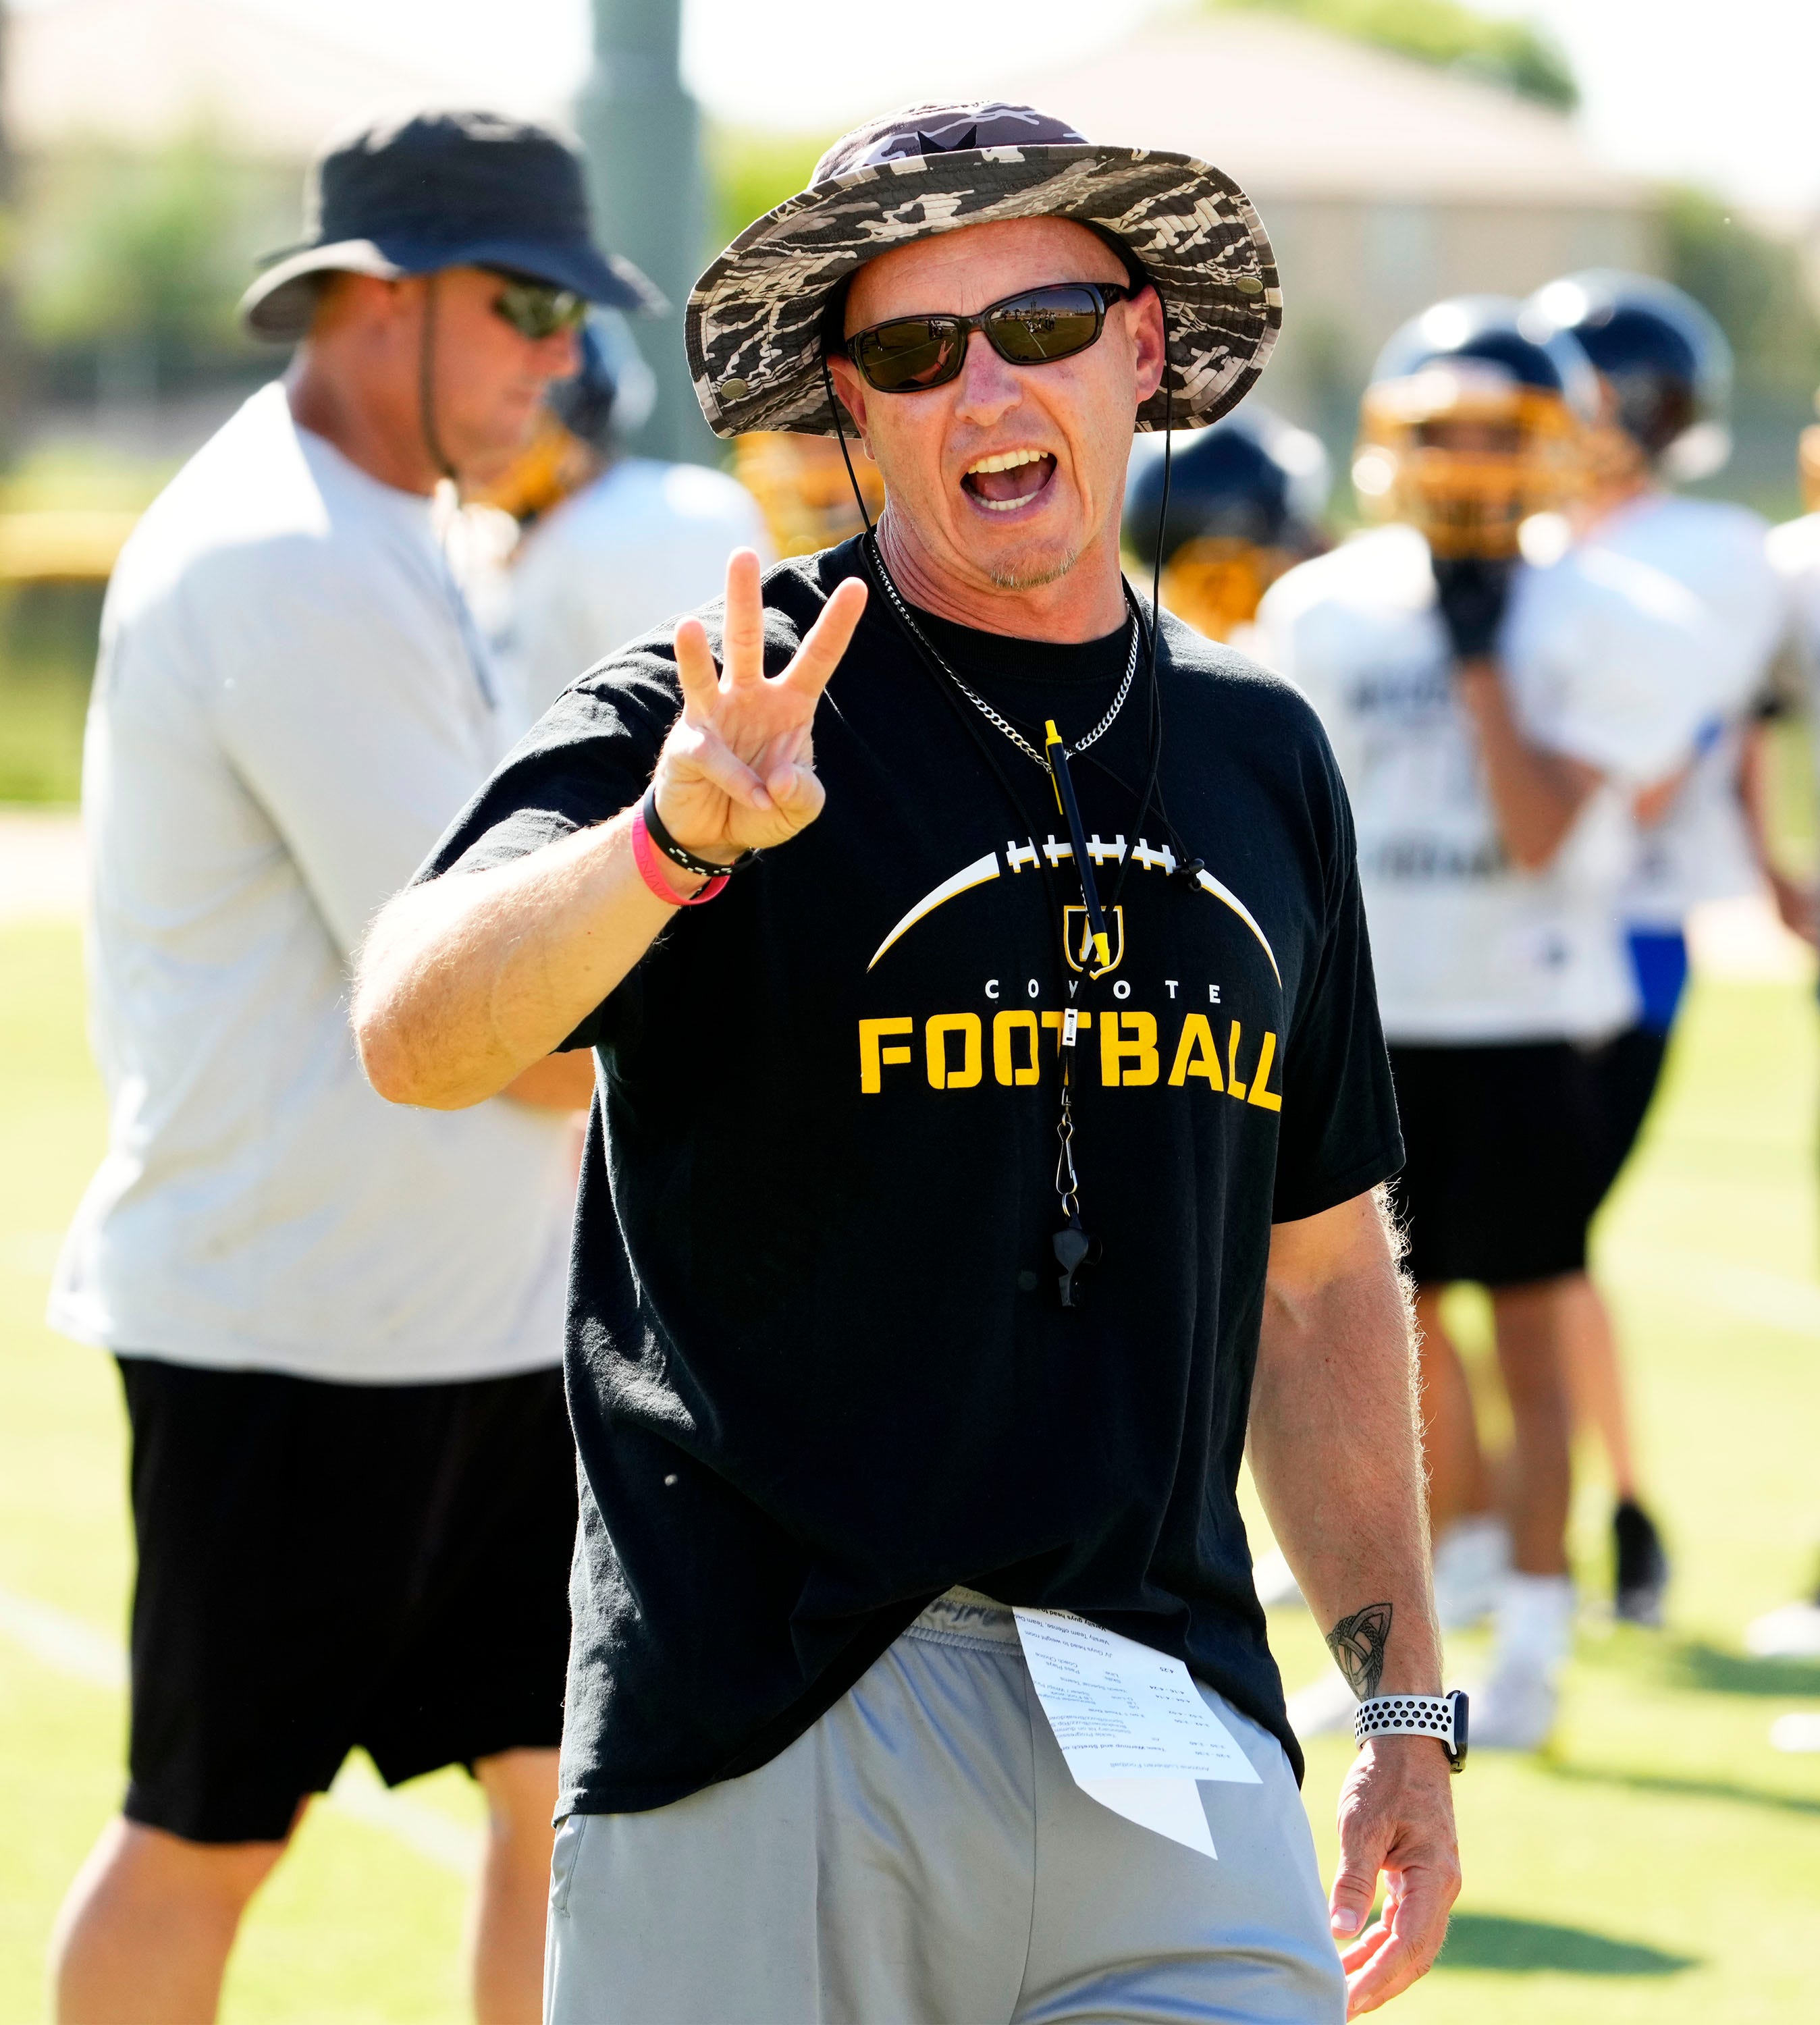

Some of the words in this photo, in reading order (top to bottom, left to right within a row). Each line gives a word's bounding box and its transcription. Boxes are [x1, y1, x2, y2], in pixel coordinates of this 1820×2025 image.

[985, 979, 1221, 1004] COYOTE
[859, 1010, 1282, 1112] FOOTBALL
[1050, 1611, 1065, 1619] head
[1067, 1615, 1083, 1623] guys
[1027, 1618, 1044, 1628] Team
[1024, 1630, 1040, 1638] room
[1071, 1630, 1088, 1639] Team
[1041, 1636, 1061, 1644] weight
[1089, 1634, 1110, 1646] Varsity
[1070, 1642, 1086, 1652] head
[1087, 1647, 1103, 1656] Guys
